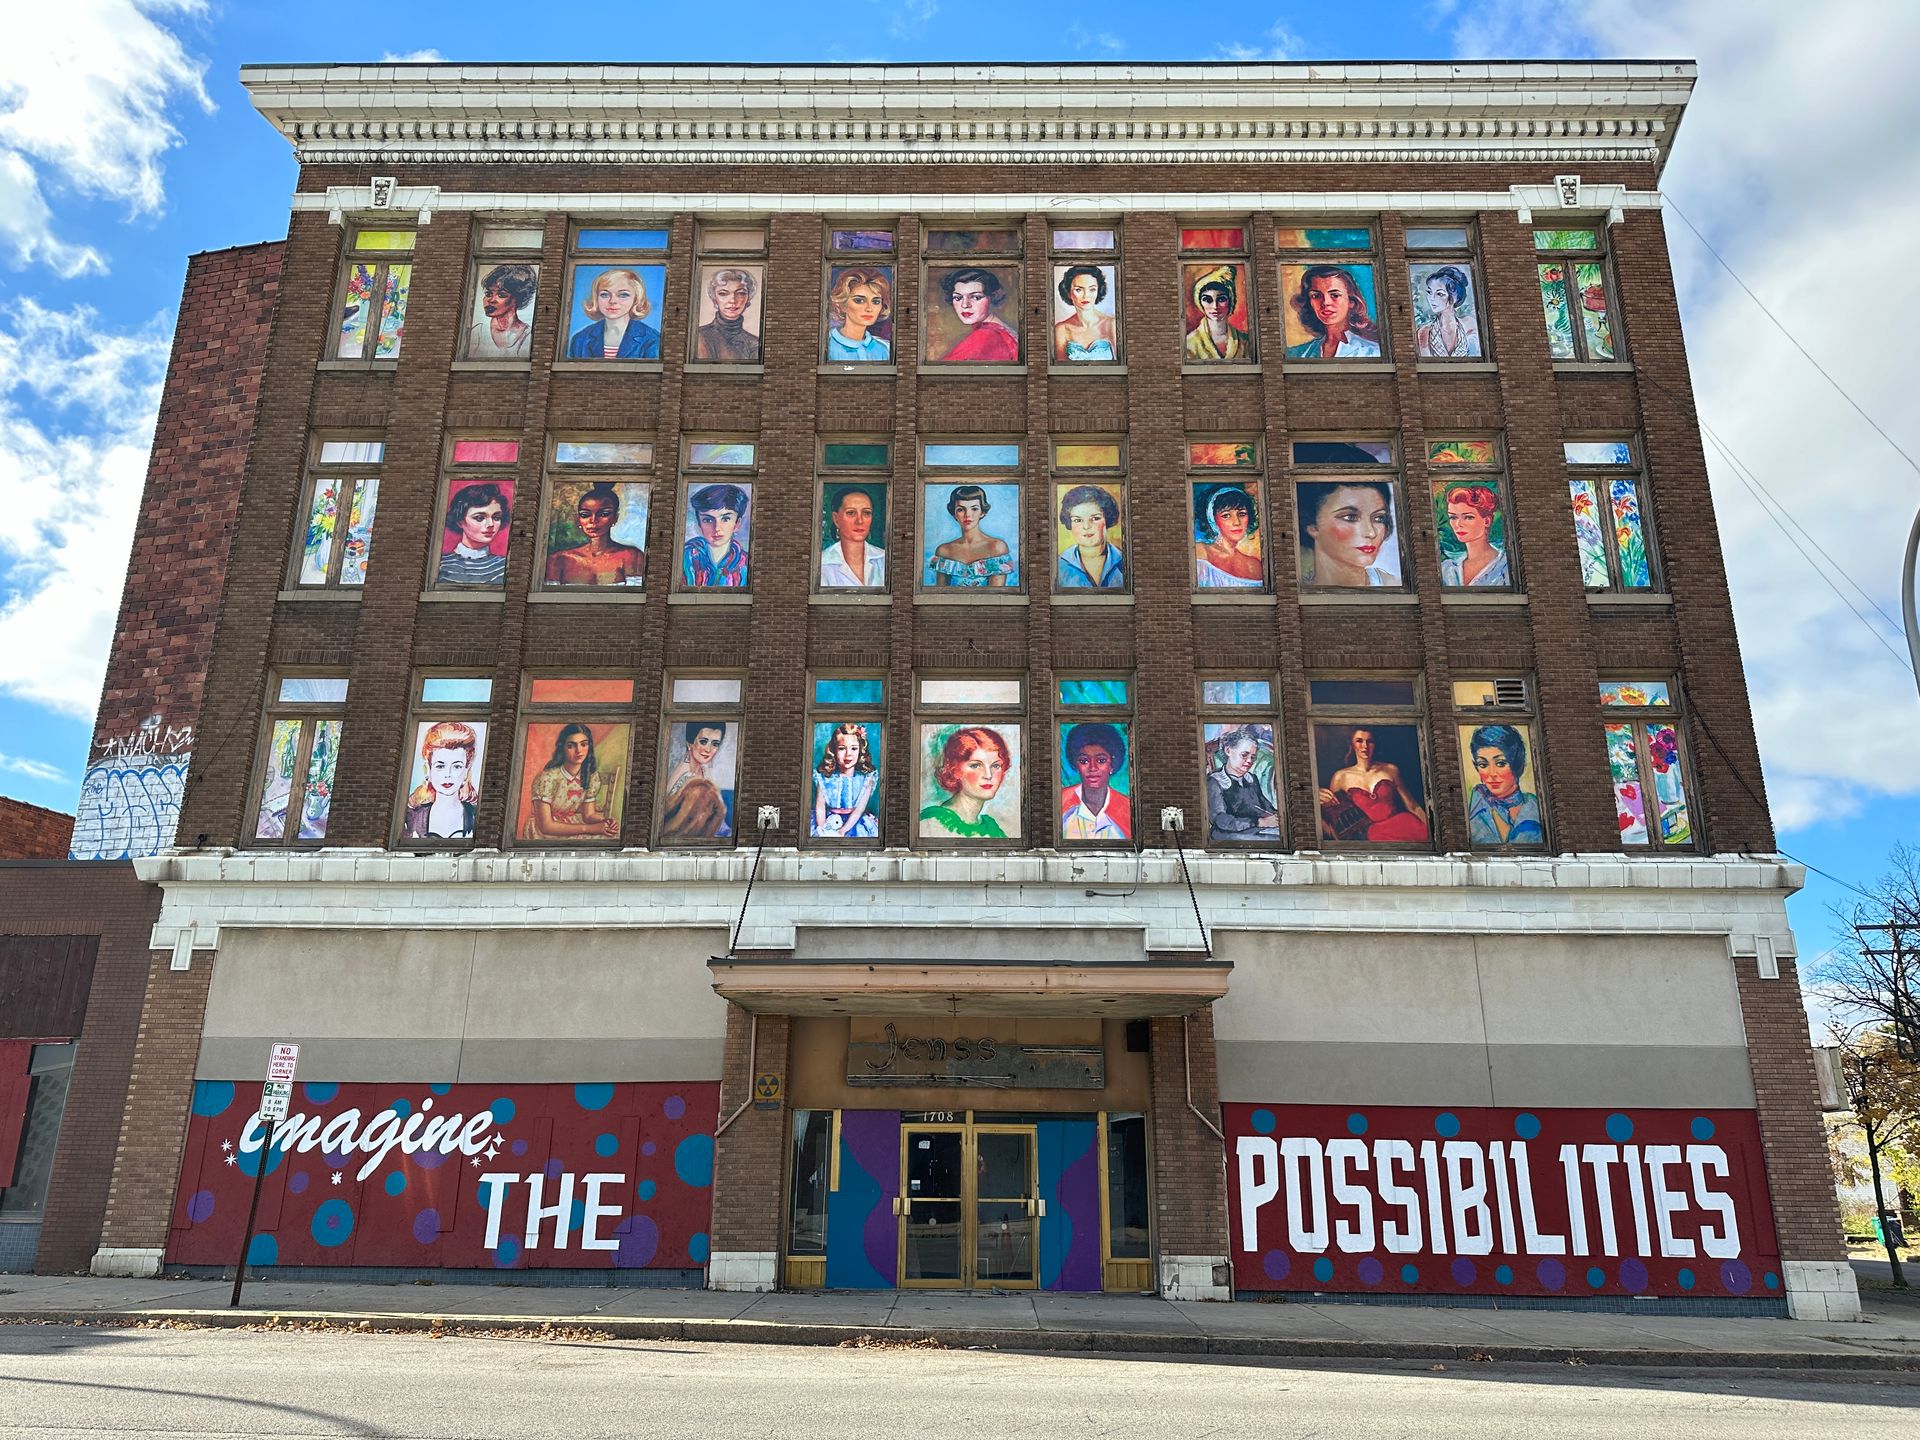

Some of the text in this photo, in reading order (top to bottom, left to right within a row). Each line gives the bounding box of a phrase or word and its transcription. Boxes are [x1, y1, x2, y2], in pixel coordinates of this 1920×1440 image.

[280, 1047, 291, 1055] NO
[864, 1022, 997, 1070] Jenss
[265, 1085, 272, 1094] 2
[923, 1111, 954, 1122] 1708
[478, 1173, 626, 1251] THE
[1236, 1136, 1741, 1259] POSSIBILITIES
